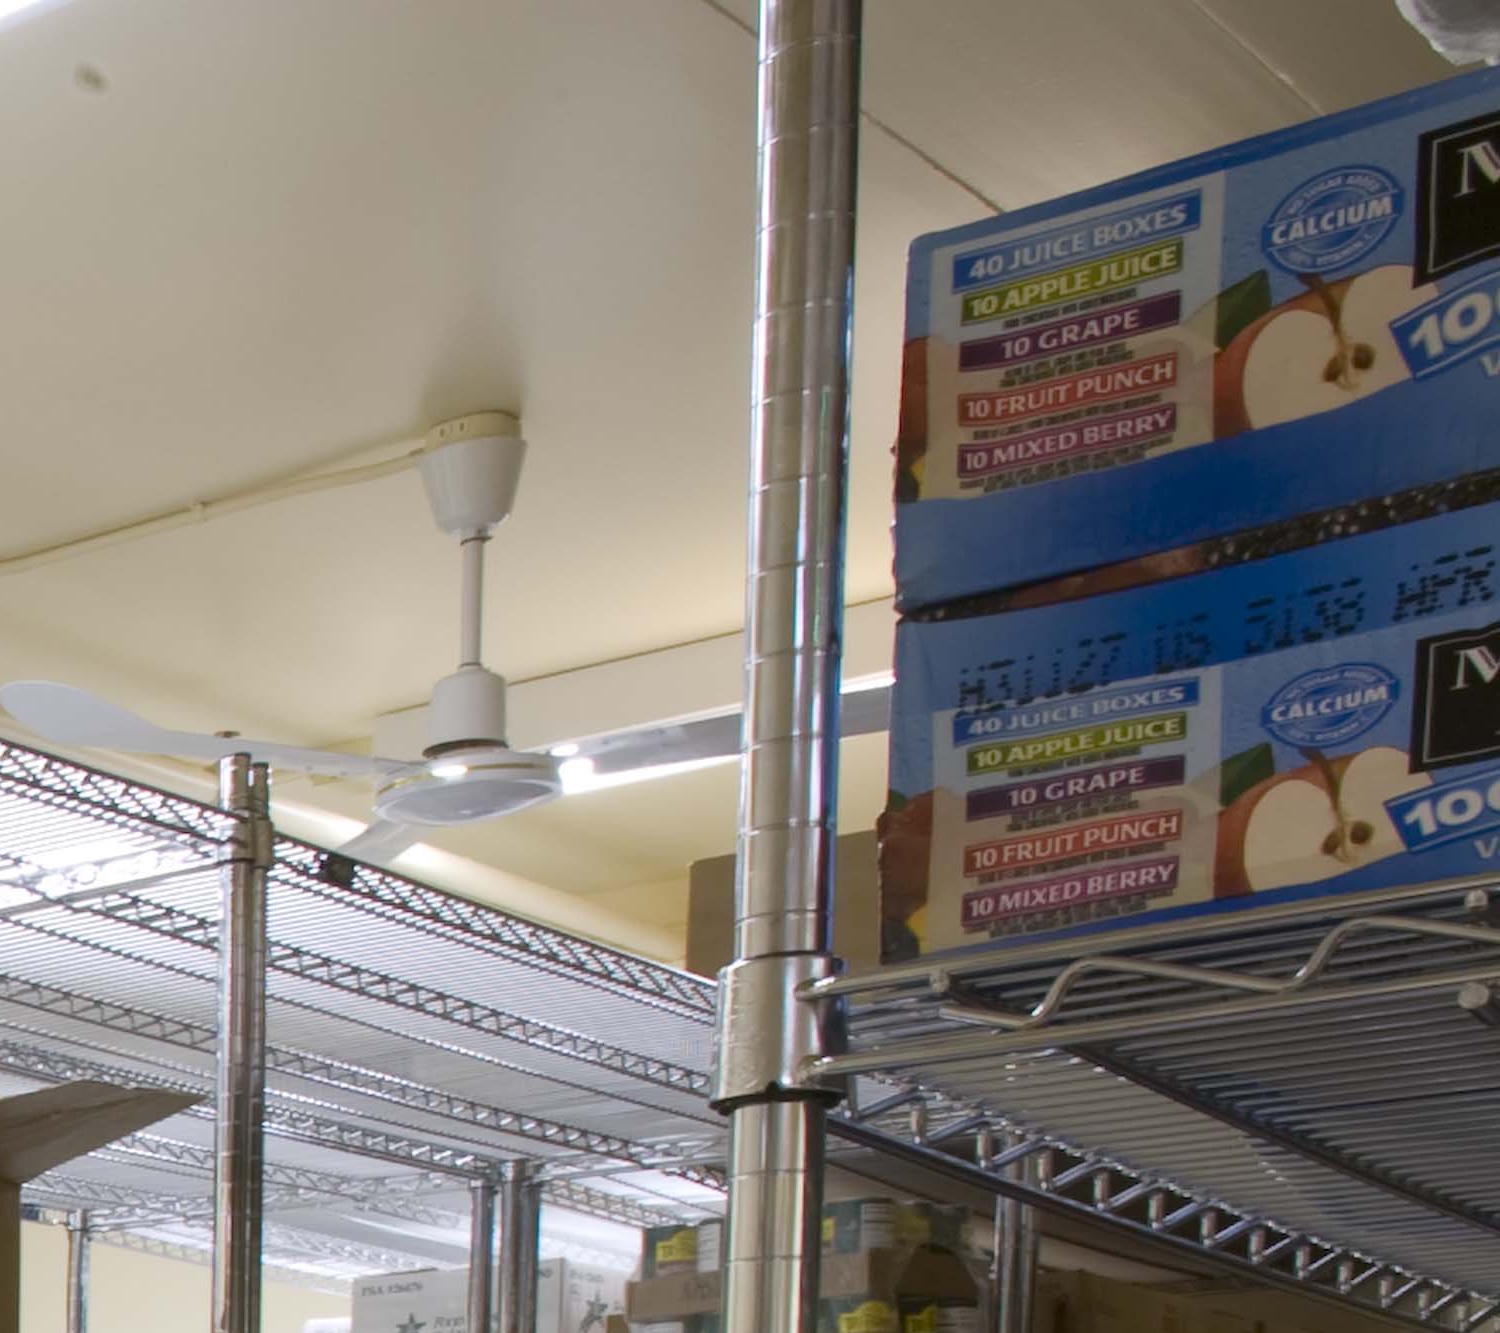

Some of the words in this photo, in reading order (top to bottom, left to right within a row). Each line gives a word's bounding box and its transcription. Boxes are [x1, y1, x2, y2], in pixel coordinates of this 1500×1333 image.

[969, 256, 1004, 279] 40
[1009, 232, 1087, 270] JUICE
[1093, 203, 1188, 247] BOXES
[1271, 196, 1393, 244] CALCIUM
[971, 295, 997, 317] 10
[1003, 270, 1092, 310] APPLE
[1095, 246, 1178, 286] JUICE
[1003, 336, 1029, 359] 10
[1038, 309, 1140, 347] GRAPE
[1408, 284, 1500, 358] 10
[967, 400, 990, 419] 10
[994, 382, 1072, 416] FRUIT
[1076, 359, 1174, 399] PUNCH
[964, 450, 987, 471] 10
[993, 431, 1077, 464] MIXED
[1083, 410, 1174, 444] BERRY
[967, 717, 1000, 736] 40
[1009, 703, 1088, 730] JUICE
[1092, 686, 1185, 716] BOXES
[1270, 684, 1391, 724] CALCIUM
[974, 747, 1001, 767] 10
[1006, 731, 1096, 765] APPLE
[1099, 717, 1182, 750] JUICE
[1010, 785, 1036, 806] 10
[1045, 767, 1145, 801] GRAPE
[1404, 780, 1500, 838] 10
[973, 847, 998, 868] 10
[1003, 834, 1077, 865] FRUIT
[1082, 816, 1178, 848] PUNCH
[970, 898, 994, 917] 10
[999, 881, 1082, 911] MIXED
[1086, 863, 1176, 896] BERRY
